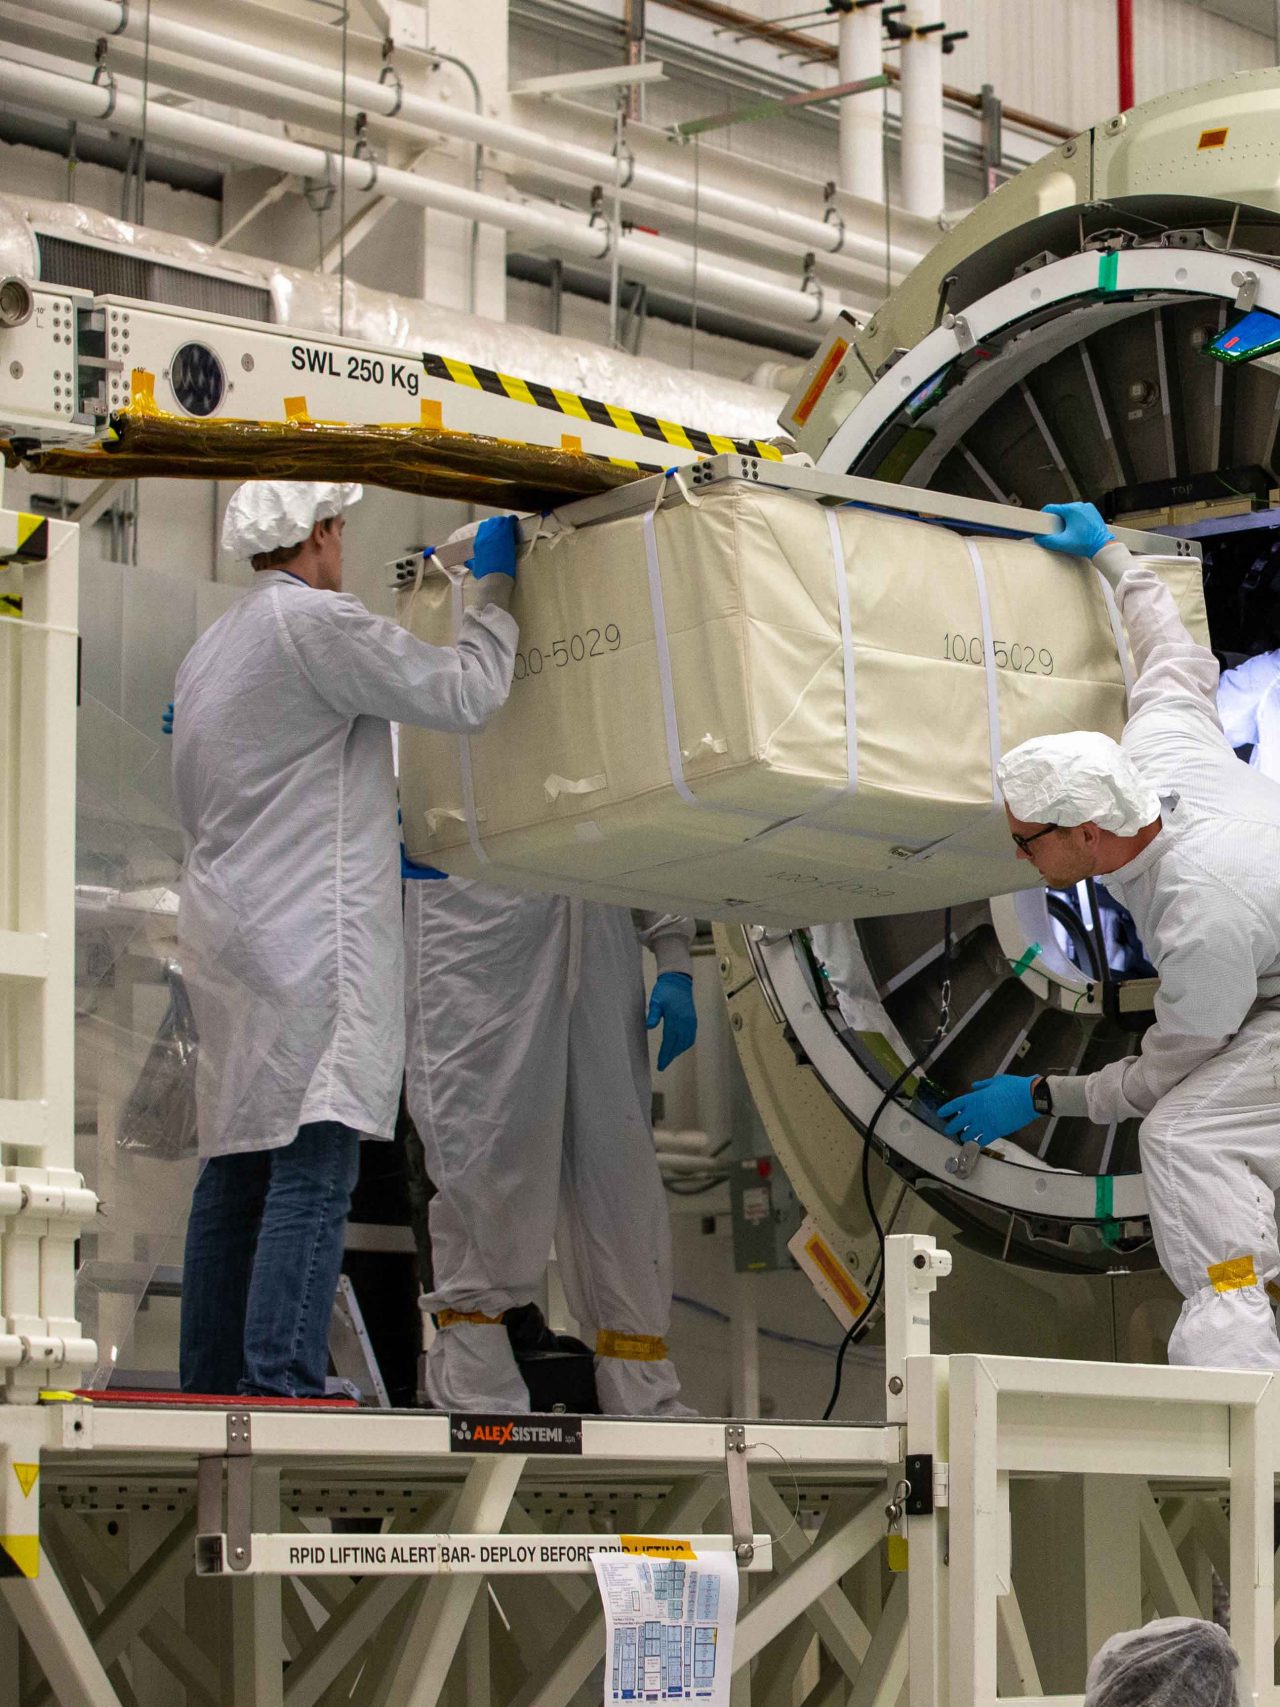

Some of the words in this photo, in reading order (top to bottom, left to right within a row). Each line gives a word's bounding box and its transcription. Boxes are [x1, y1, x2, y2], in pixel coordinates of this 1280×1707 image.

[291, 345, 341, 377] SWL
[347, 356, 385, 385] 250
[391, 363, 419, 396] Kg
[1171, 483, 1193, 497] TOP
[512, 623, 621, 683] 0.0-5029
[289, 1547, 325, 1564] RPID
[330, 1547, 386, 1563] LIFTING
[390, 1547, 437, 1563] ALERT
[441, 1546, 476, 1563] BAR-
[480, 1546, 536, 1563] DEPLOY
[540, 1546, 595, 1562] BEFORE
